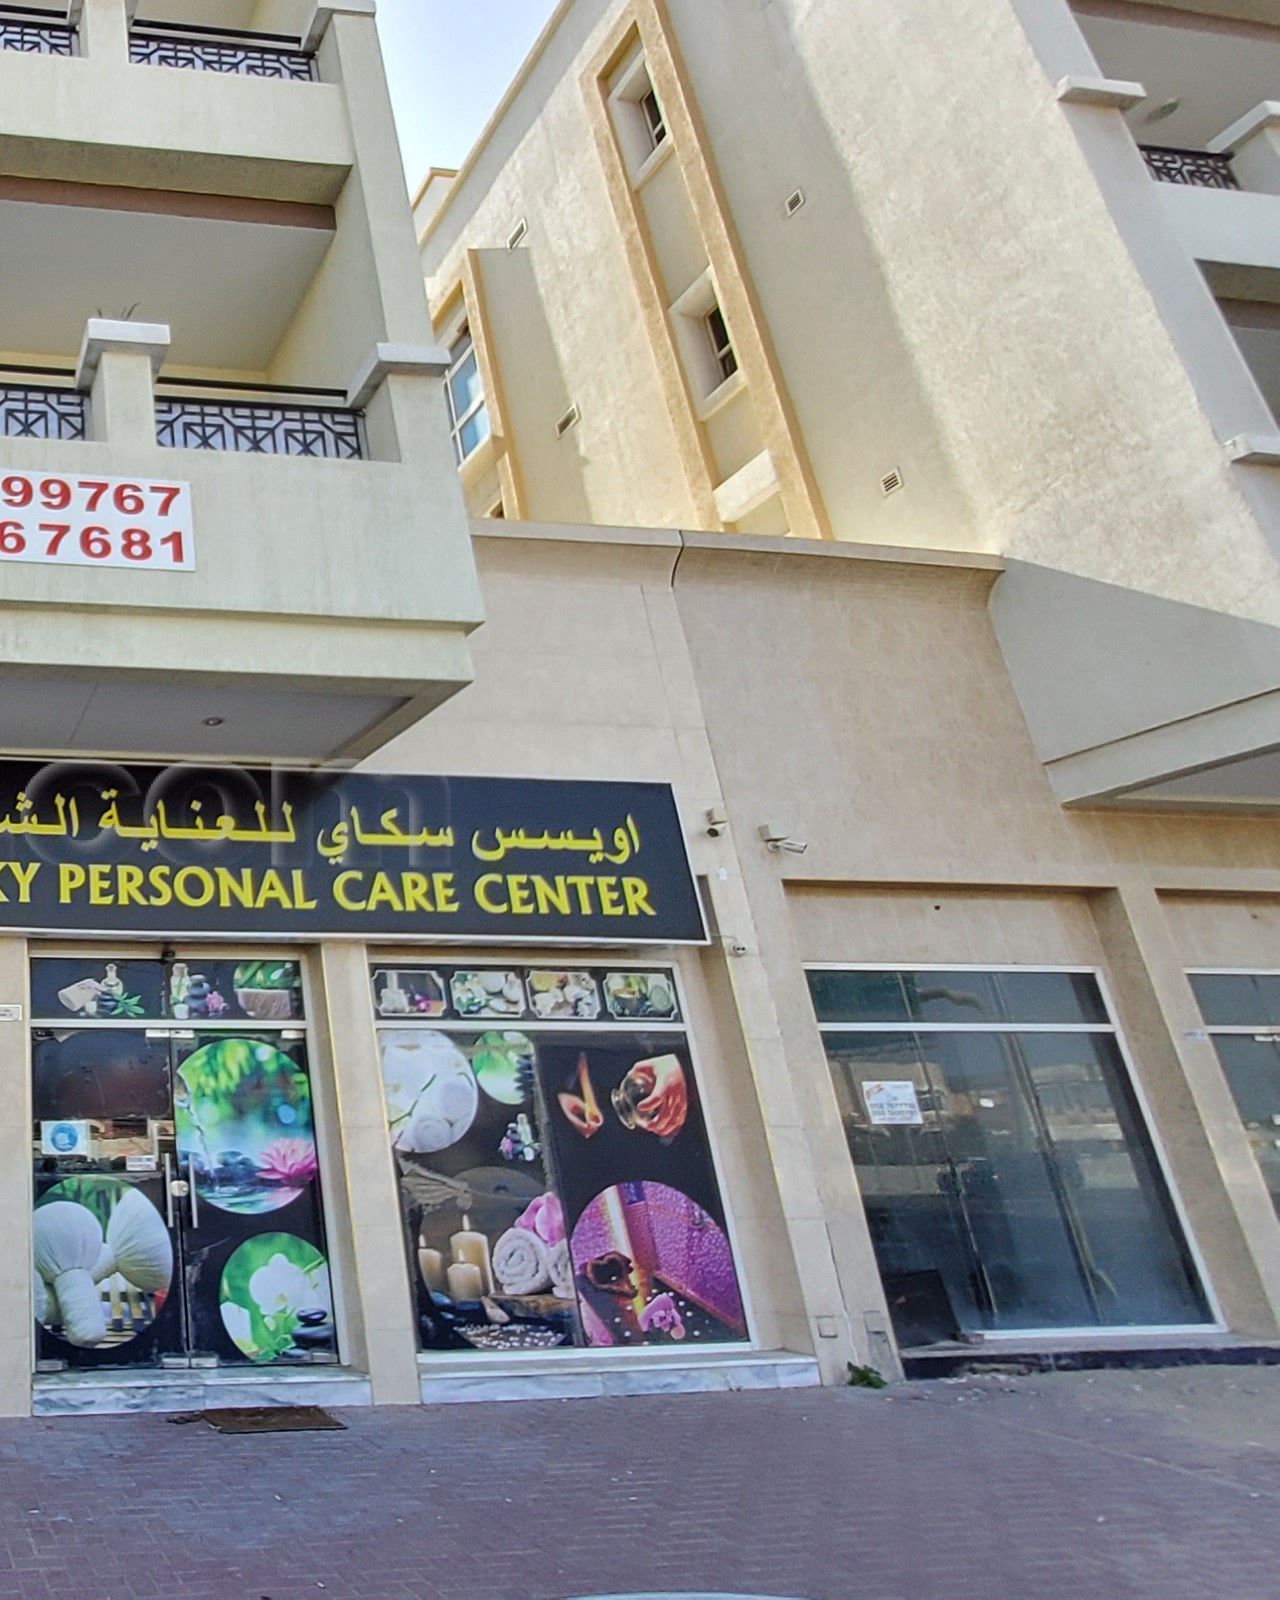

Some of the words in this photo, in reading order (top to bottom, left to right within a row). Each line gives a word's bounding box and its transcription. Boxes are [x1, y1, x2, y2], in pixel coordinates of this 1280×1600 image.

[98, 788, 296, 852] للعناية
[317, 805, 455, 865] سكاي
[58, 863, 318, 910] PERSONAL
[332, 870, 460, 912] CARE
[473, 873, 656, 916] CENTER
